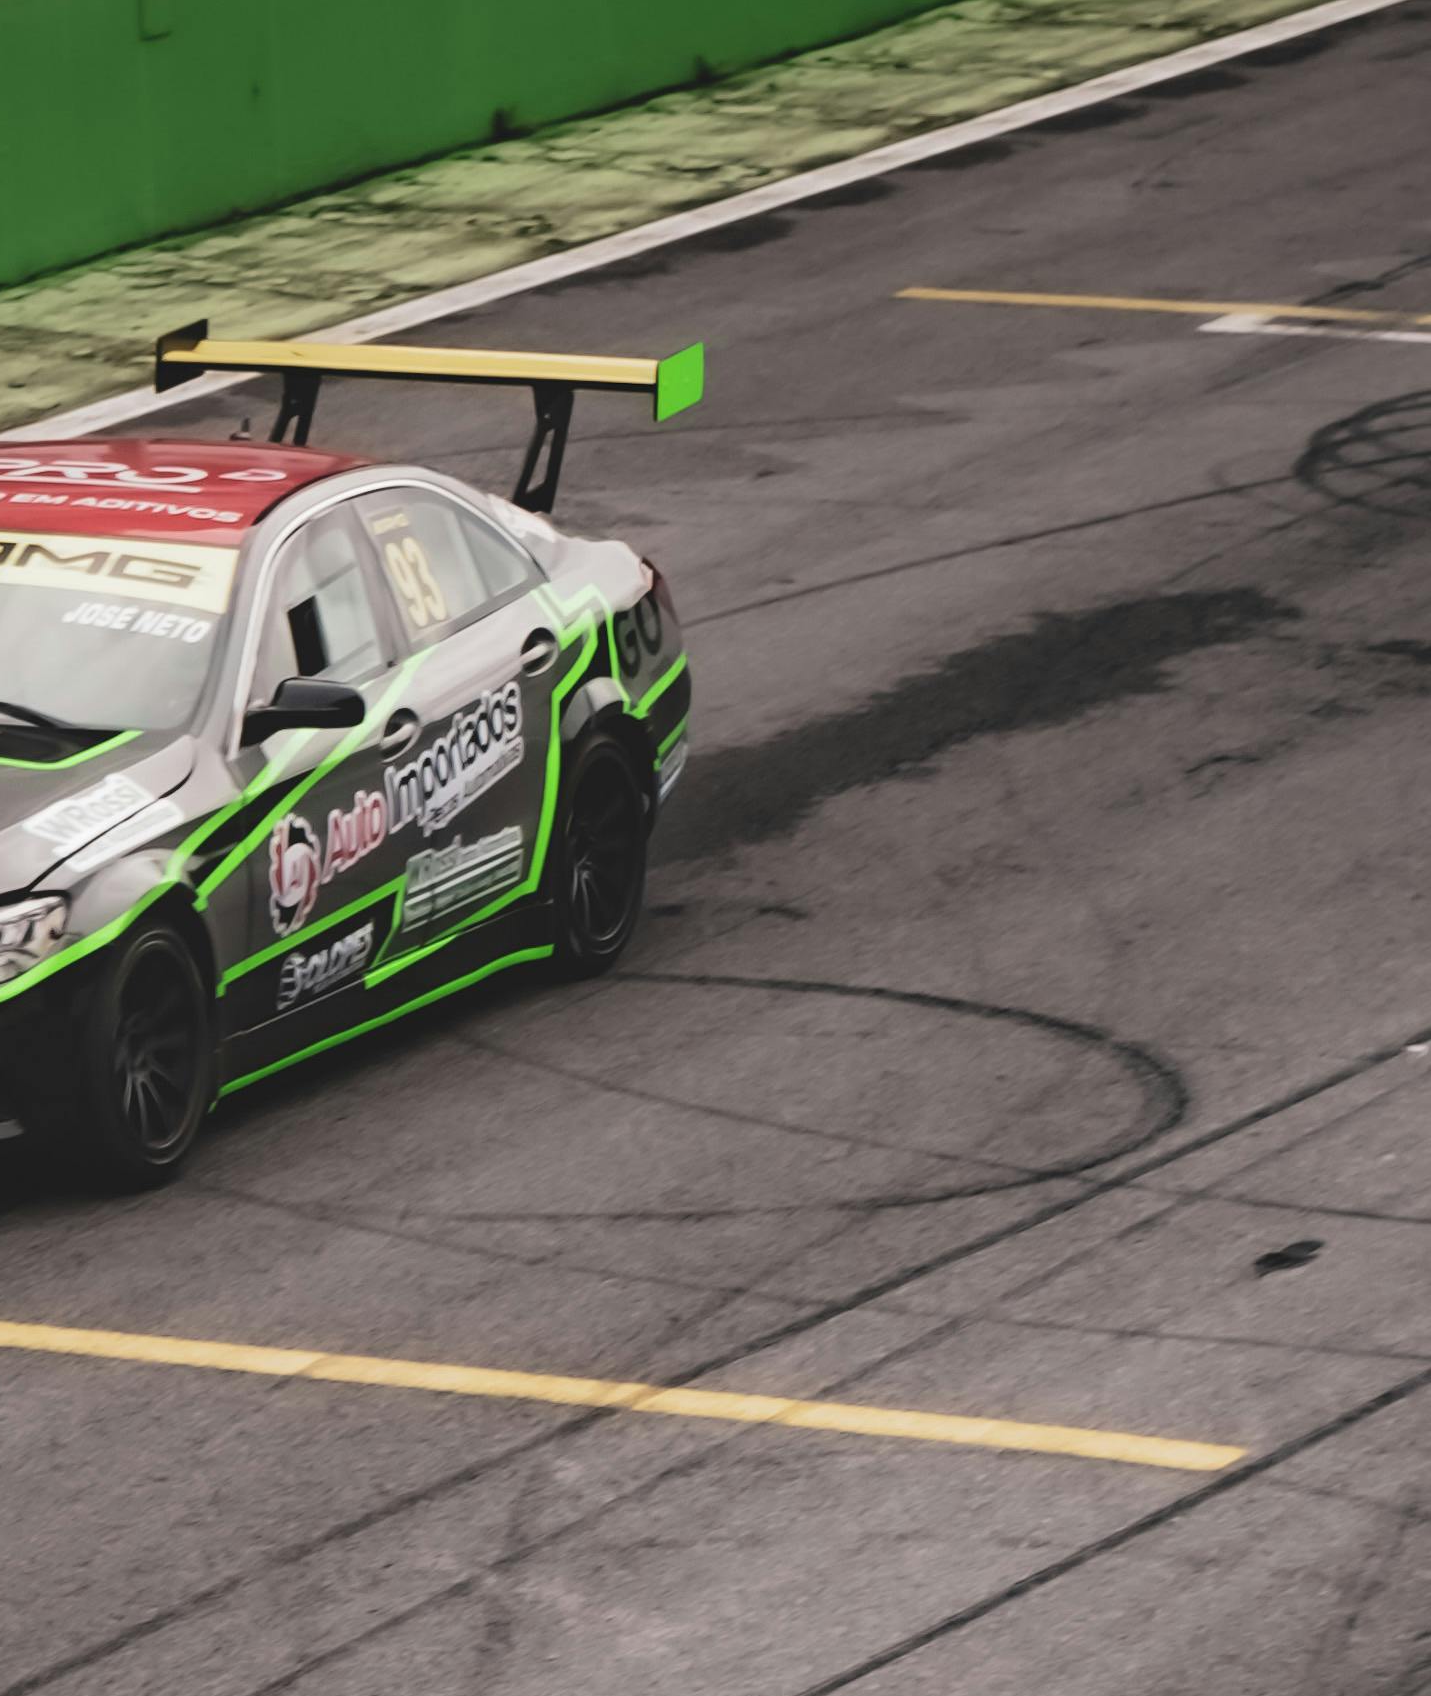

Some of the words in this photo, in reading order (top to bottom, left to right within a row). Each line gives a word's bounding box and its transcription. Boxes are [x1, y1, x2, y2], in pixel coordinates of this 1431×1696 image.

[9, 493, 69, 505] EM
[70, 497, 244, 523] ADITIVOS
[384, 536, 448, 628] 93
[61, 601, 139, 630] JOSÉ
[128, 610, 211, 644] NETO
